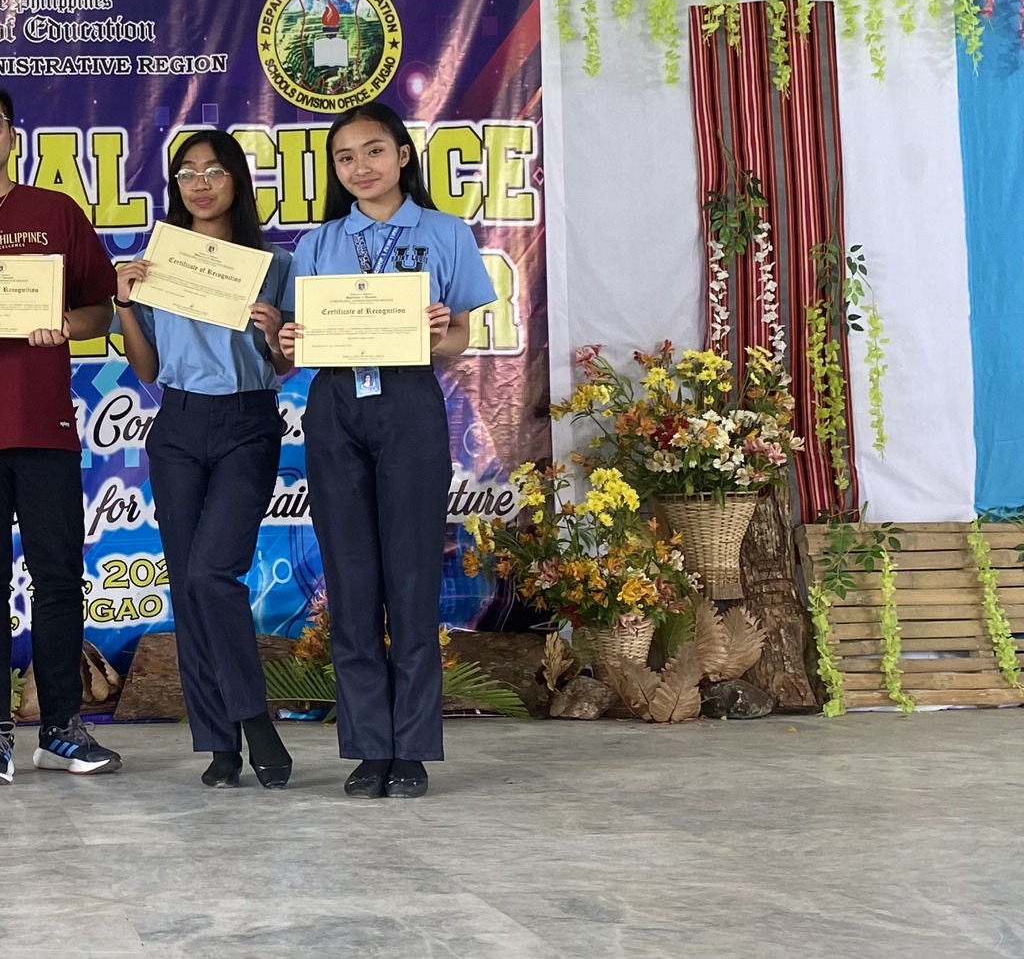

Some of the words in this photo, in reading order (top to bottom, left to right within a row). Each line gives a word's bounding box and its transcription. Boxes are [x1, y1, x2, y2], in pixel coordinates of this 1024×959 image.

[24, 15, 156, 43] Education
[136, 54, 228, 75] REGION
[265, 59, 295, 98] SCHOOLS
[295, 92, 336, 110] DIVISION
[337, 89, 371, 109] OFFICE
[374, 56, 396, 90] IFUGAO
[87, 484, 142, 536] for
[102, 558, 170, 590] 202
